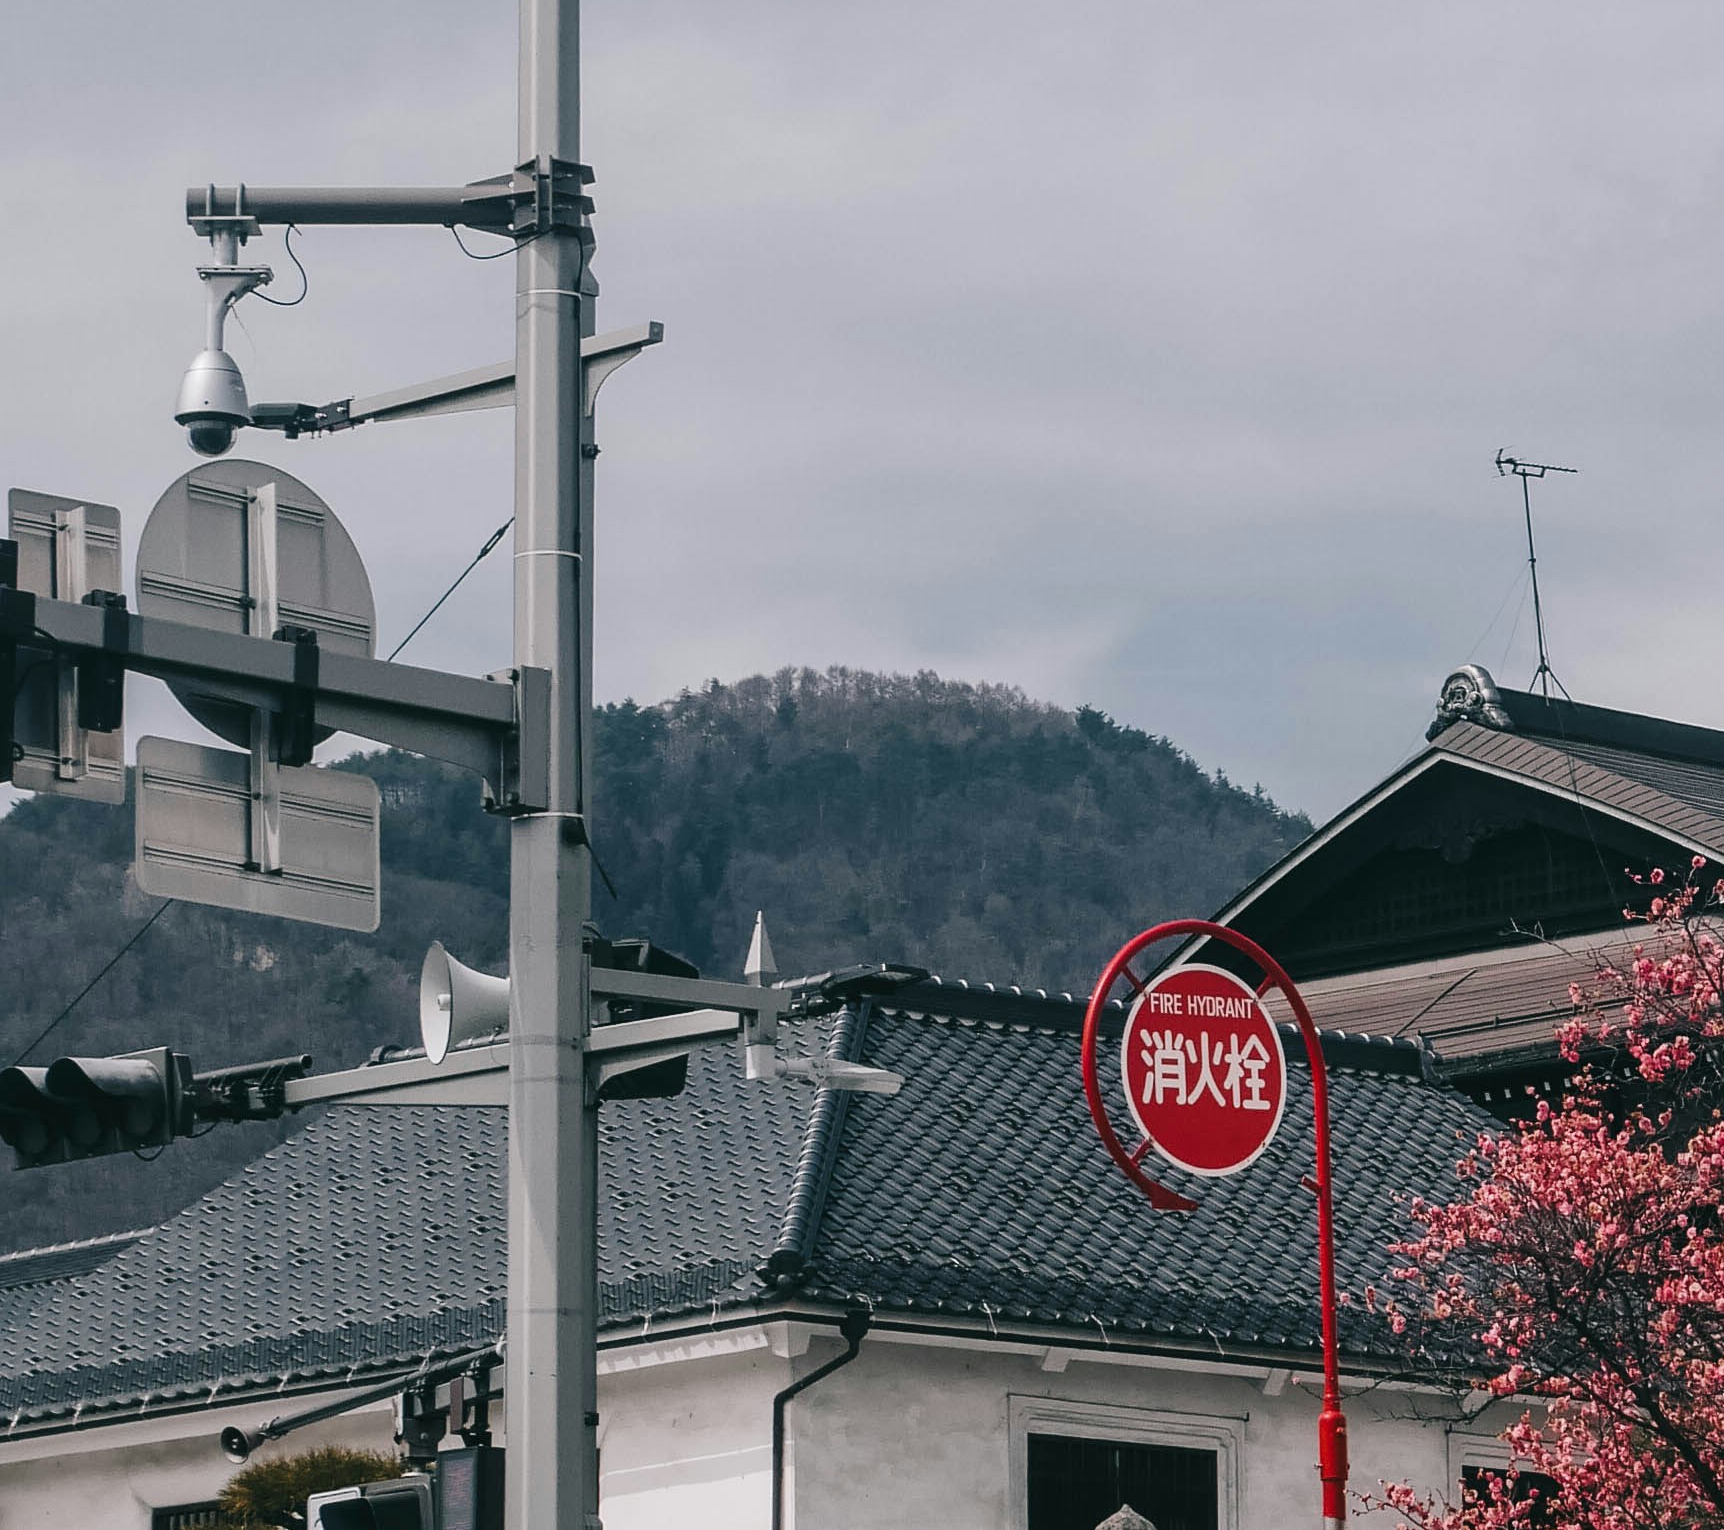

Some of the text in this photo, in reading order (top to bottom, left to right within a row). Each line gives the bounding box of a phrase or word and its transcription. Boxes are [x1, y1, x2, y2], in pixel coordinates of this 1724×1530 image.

[1150, 992, 1254, 1020] FIRE HYDRANT
[1139, 1028, 1271, 1111] 消火栓
